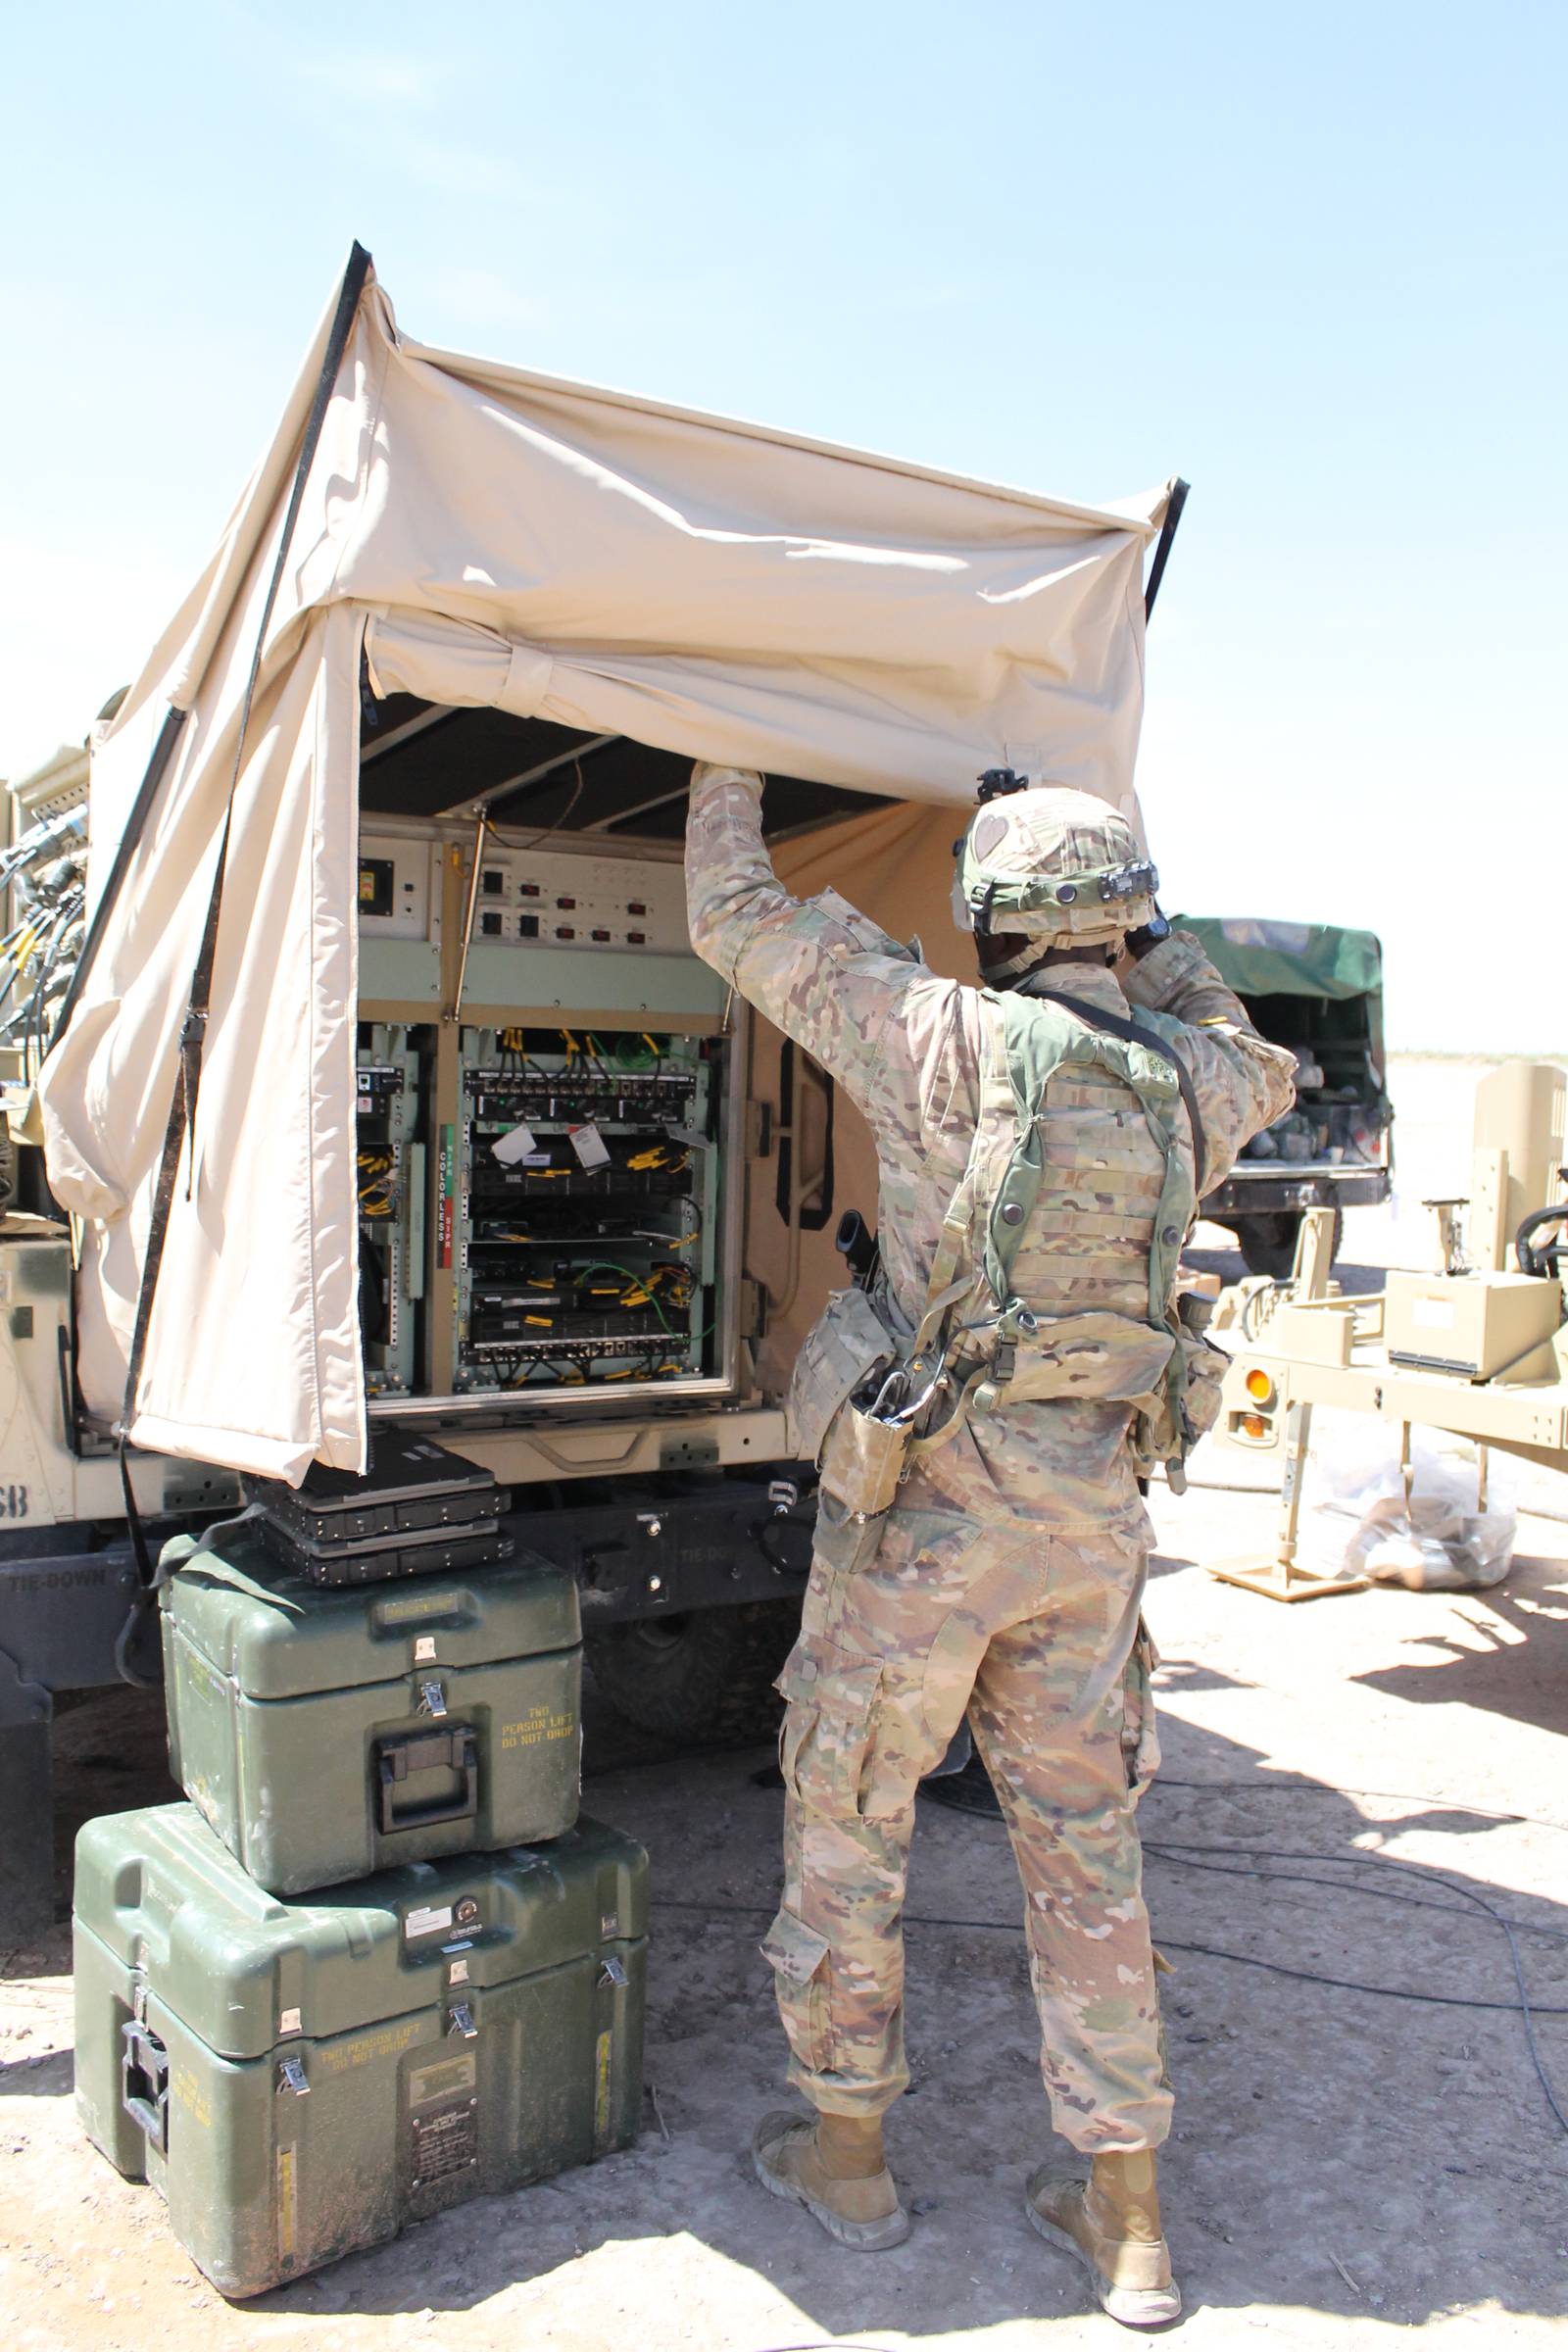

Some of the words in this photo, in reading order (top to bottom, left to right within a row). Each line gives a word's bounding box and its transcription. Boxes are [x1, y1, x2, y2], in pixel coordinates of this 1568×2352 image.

[438, 1152, 447, 1242] COLORLESS
[9, 1569, 107, 1592] TIE-DOWN
[502, 1718, 546, 1733] PERSON
[549, 1712, 573, 1727] LIFT
[529, 1707, 549, 1718] TWO
[501, 1737, 517, 1749] DO
[520, 1733, 541, 1744] NOT
[547, 1726, 573, 1740] DROP
[347, 2031, 392, 2055] PERSON
[395, 2022, 420, 2039] LIFT
